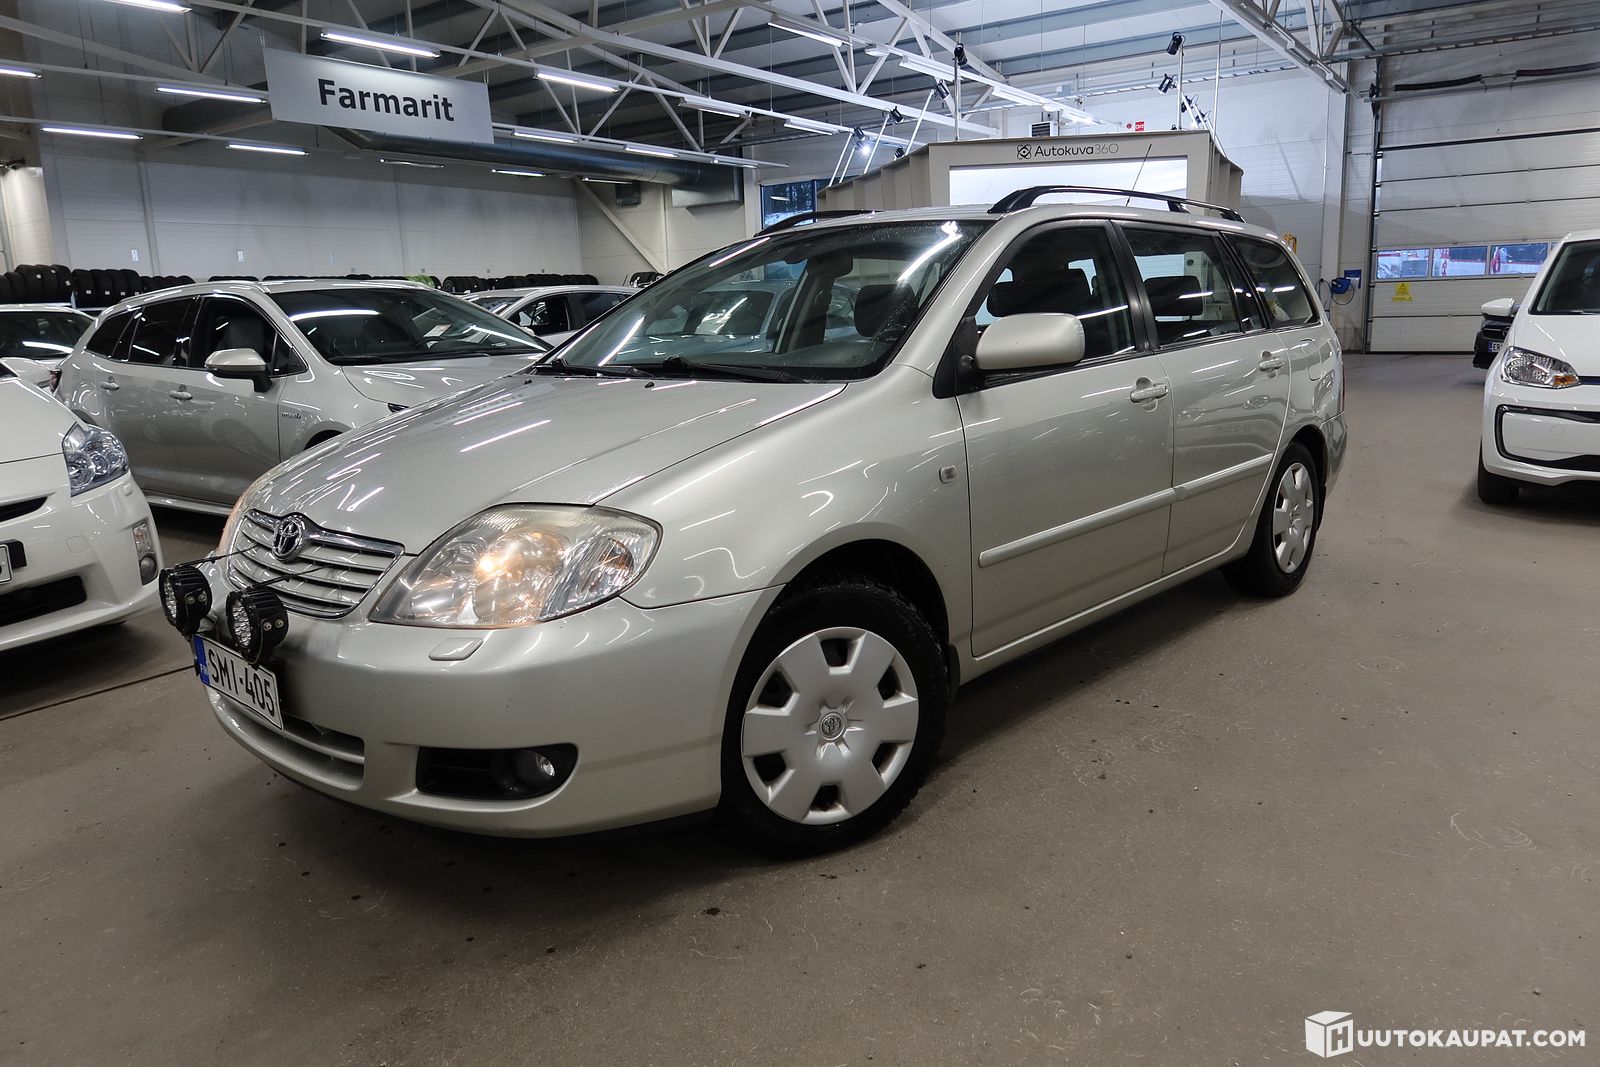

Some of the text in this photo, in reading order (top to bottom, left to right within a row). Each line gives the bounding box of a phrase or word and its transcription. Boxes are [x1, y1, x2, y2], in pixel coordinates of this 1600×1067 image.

[317, 77, 456, 123] Farmarit
[1034, 142, 1120, 158] Autokuva360
[207, 648, 276, 718] SMI-405
